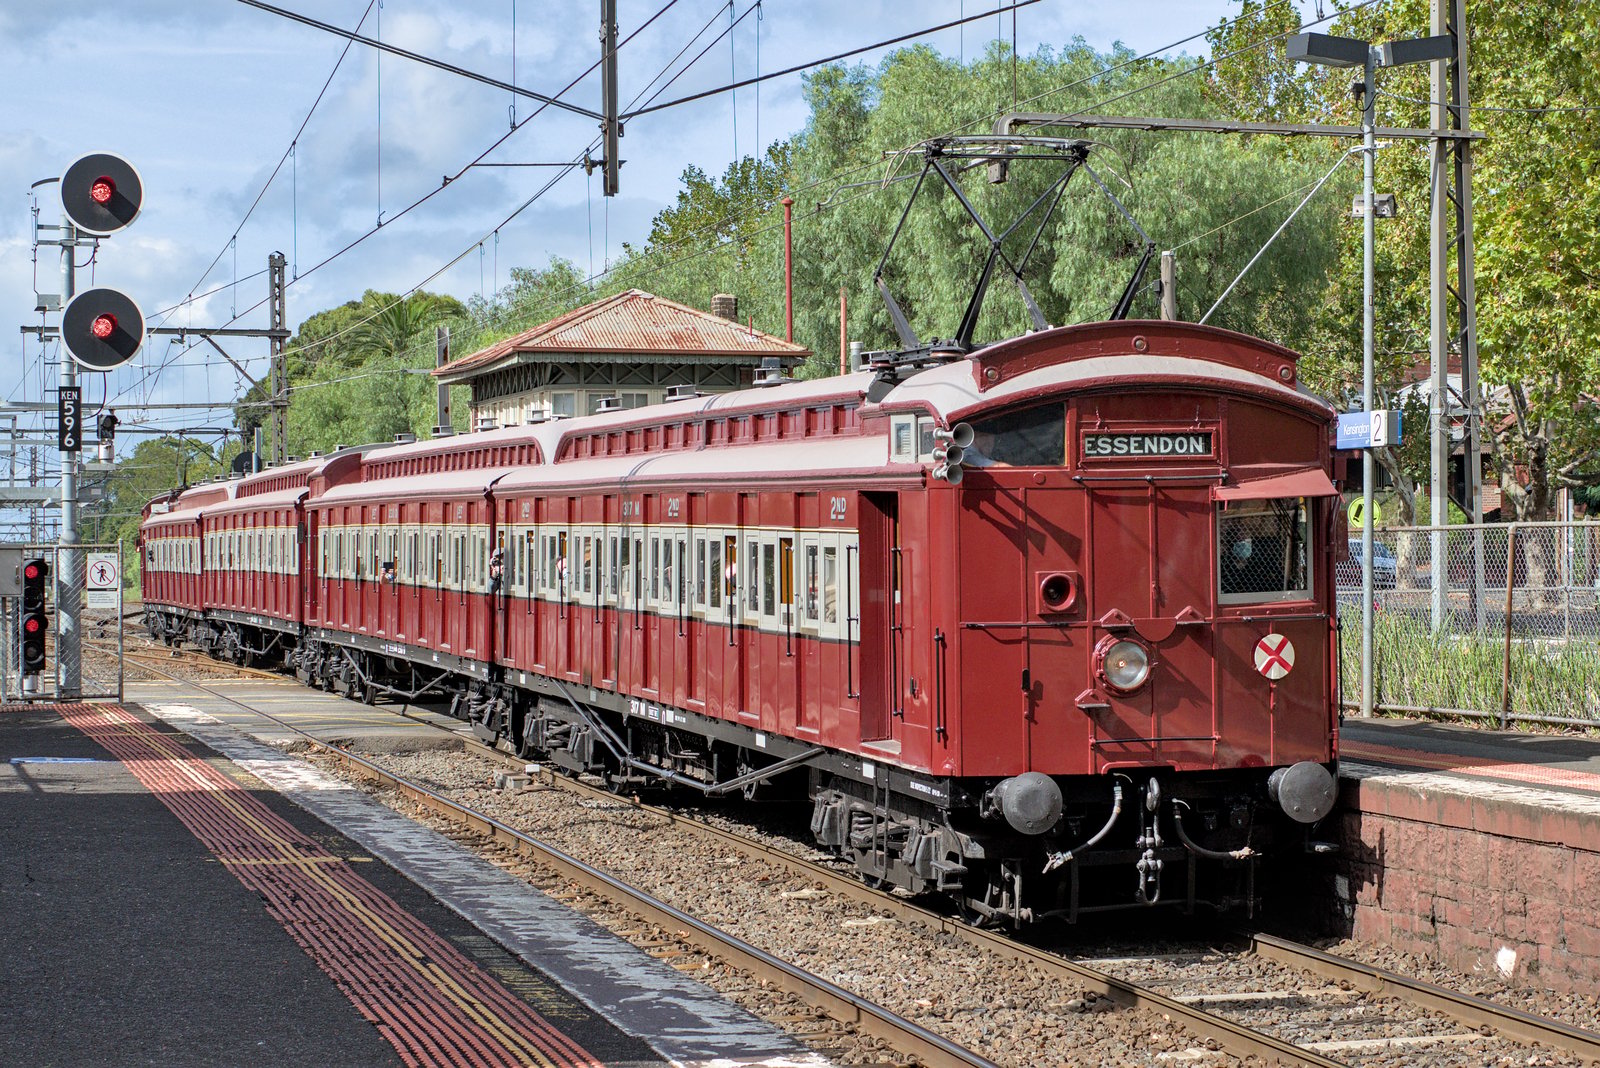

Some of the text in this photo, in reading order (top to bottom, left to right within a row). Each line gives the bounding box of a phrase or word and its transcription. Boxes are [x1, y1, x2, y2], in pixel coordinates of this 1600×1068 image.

[61, 391, 78, 400] KEN
[64, 401, 75, 447] 596
[1343, 413, 1382, 442] Kensington 2
[1084, 436, 1203, 454] ESSENDON
[668, 497, 680, 517] 2ND
[831, 496, 847, 520] 2ND
